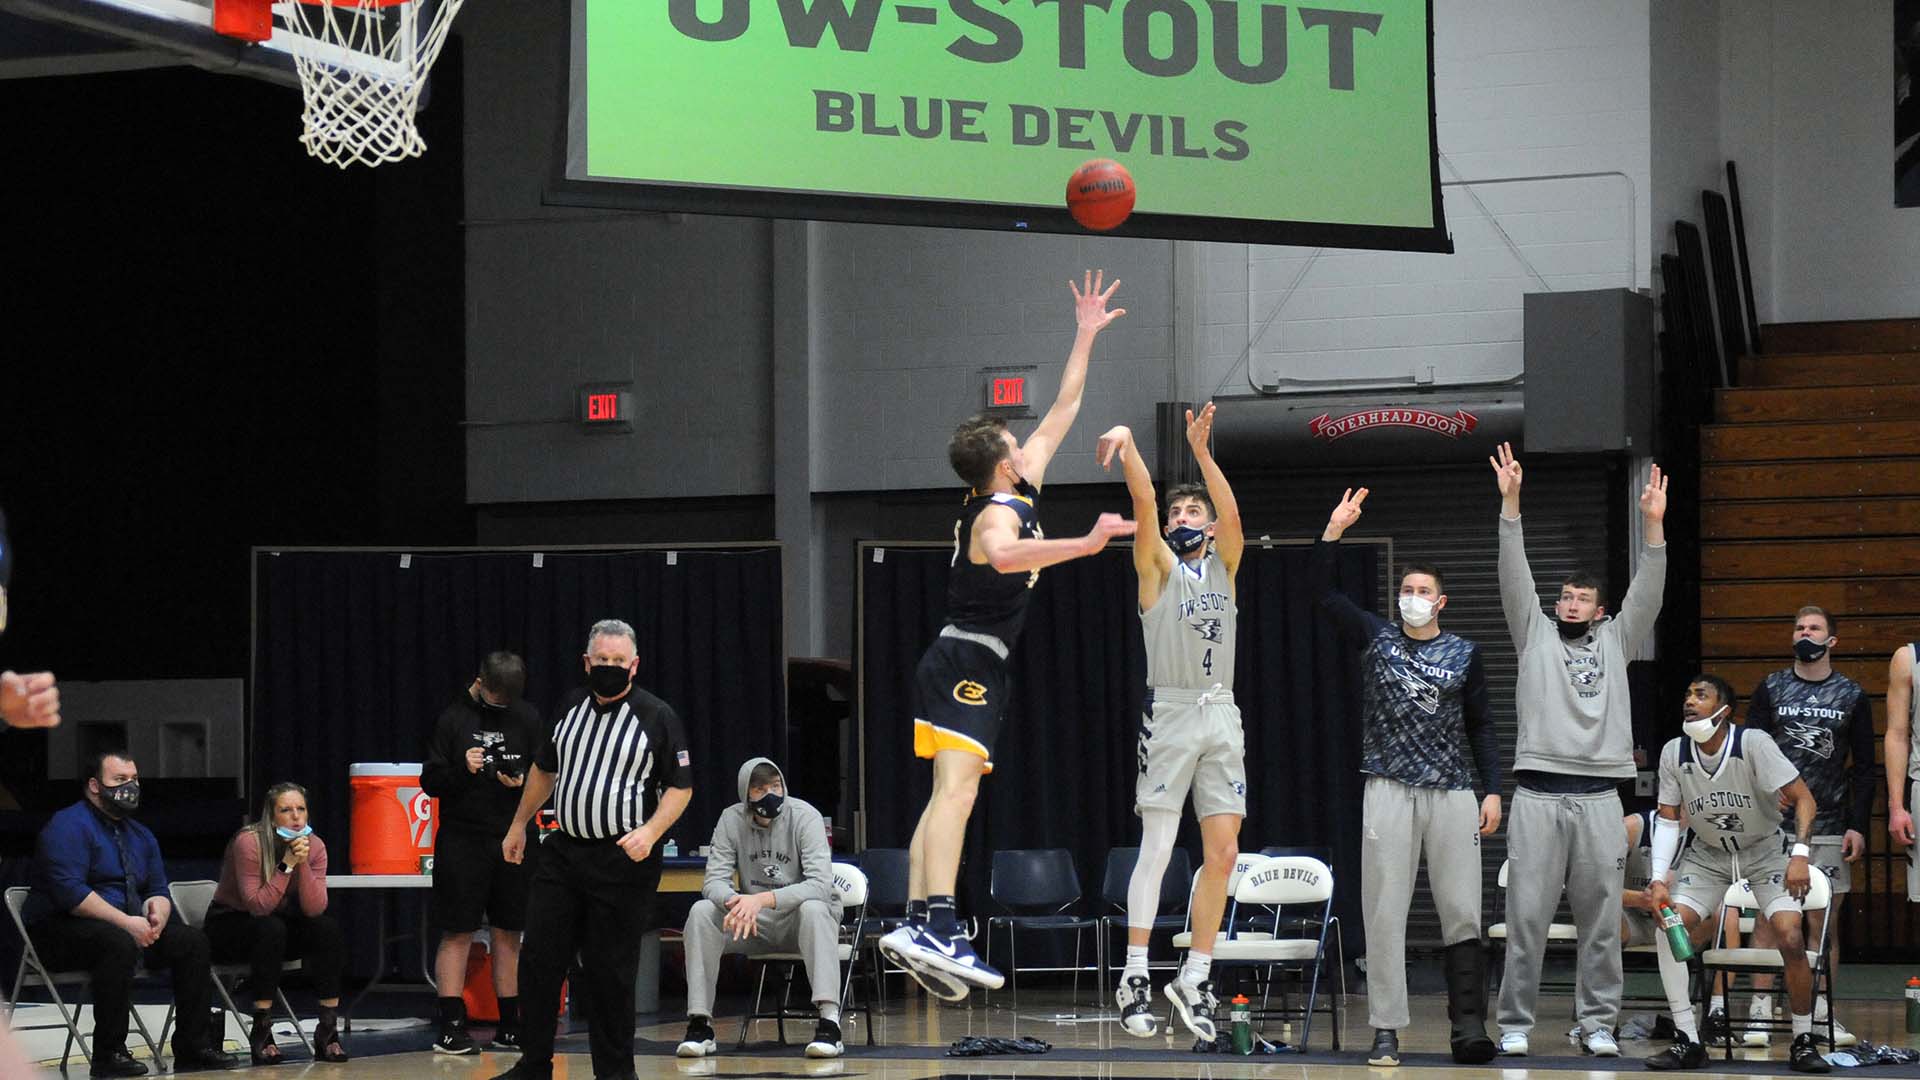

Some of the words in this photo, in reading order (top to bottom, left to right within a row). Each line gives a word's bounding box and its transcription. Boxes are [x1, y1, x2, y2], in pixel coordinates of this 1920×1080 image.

[812, 89, 989, 143] BLUE
[1008, 103, 1251, 162] DEVILS
[993, 377, 1024, 405] EXIT
[588, 393, 617, 420] EXIT
[1326, 411, 1412, 437] OVERHEAD
[1415, 413, 1457, 436] DOOR
[1202, 648, 1212, 676] 4
[1778, 706, 1845, 720] UW-STOUT
[414, 792, 431, 821] G
[1688, 791, 1751, 815] UW-STOUT
[1720, 835, 1740, 854] 11
[833, 874, 852, 892] VILS
[1250, 869, 1279, 887] BLUE
[1283, 868, 1319, 886] DEVILS
